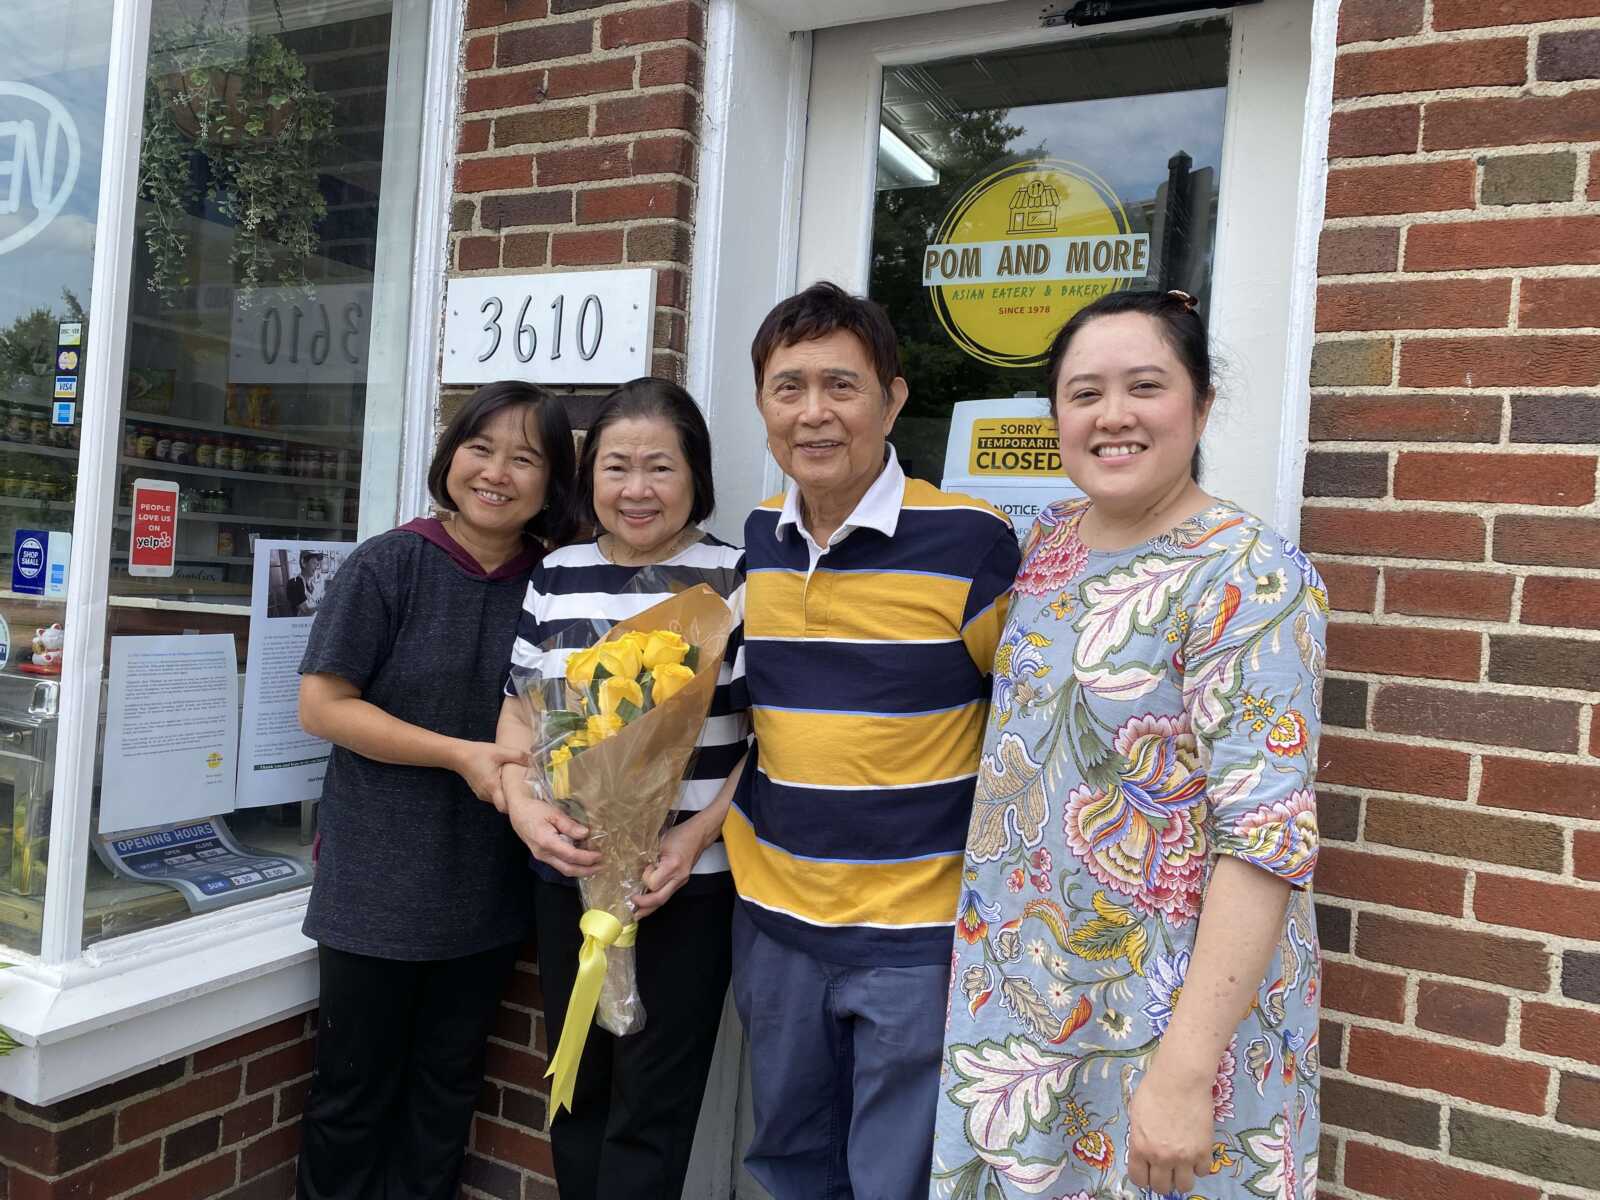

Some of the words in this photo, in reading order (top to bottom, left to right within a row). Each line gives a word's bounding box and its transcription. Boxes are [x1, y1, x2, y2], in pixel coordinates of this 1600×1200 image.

[925, 247, 981, 280] POM
[997, 243, 1050, 276] AND
[1066, 238, 1147, 274] MORE
[952, 289, 985, 300] ASIAN
[992, 286, 1036, 299] EATERY
[1044, 287, 1051, 297] &
[1061, 283, 1107, 297] BAKERY
[998, 307, 1024, 315] SINCE
[1029, 306, 1050, 314] 1978
[478, 294, 603, 363] 3610
[59, 383, 73, 391] VISA
[1000, 424, 1041, 435] SORRY
[981, 438, 1060, 449] TEMPORARILY
[976, 451, 1063, 471] CLOSED
[140, 503, 171, 512] PEOPLE
[138, 513, 160, 521] LOVE
[161, 514, 171, 522] US
[137, 536, 160, 550] yelp
[23, 550, 39, 558] SHOP
[21, 557, 40, 566] SMALL
[118, 832, 171, 851] OPENING
[174, 824, 213, 840] HOURS
